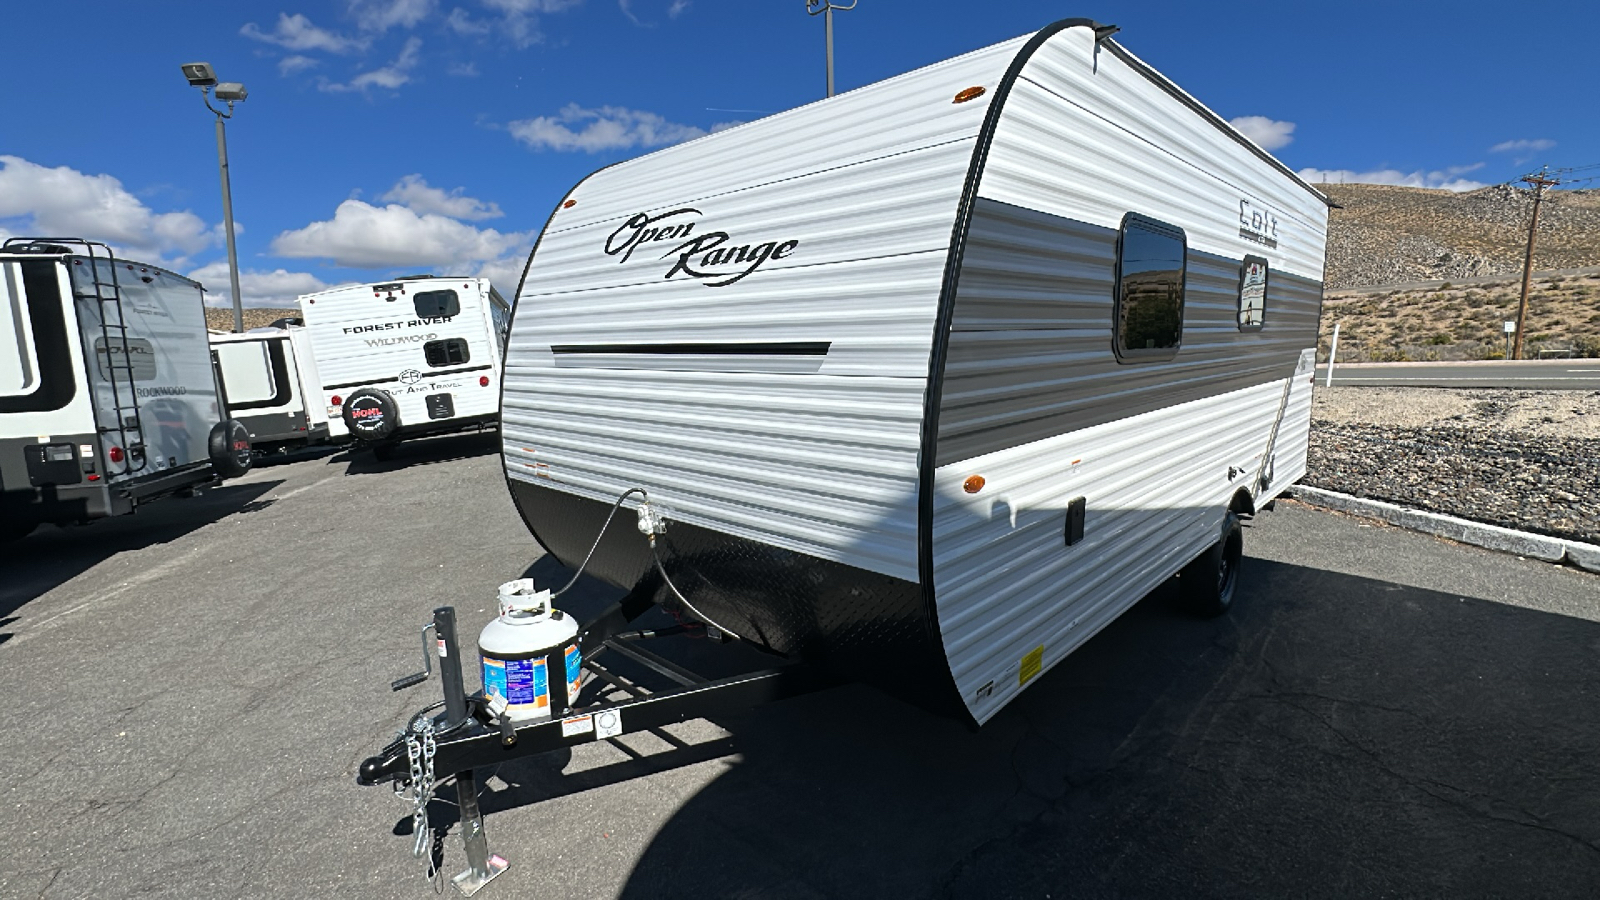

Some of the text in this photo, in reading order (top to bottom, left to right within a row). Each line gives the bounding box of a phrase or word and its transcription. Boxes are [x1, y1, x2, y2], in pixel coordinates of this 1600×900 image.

[604, 207, 703, 264] Open
[1239, 198, 1278, 237] Colt
[659, 231, 799, 287] Range
[342, 316, 453, 335] FOREST RIVER
[136, 385, 187, 399] ROCKWOOD
